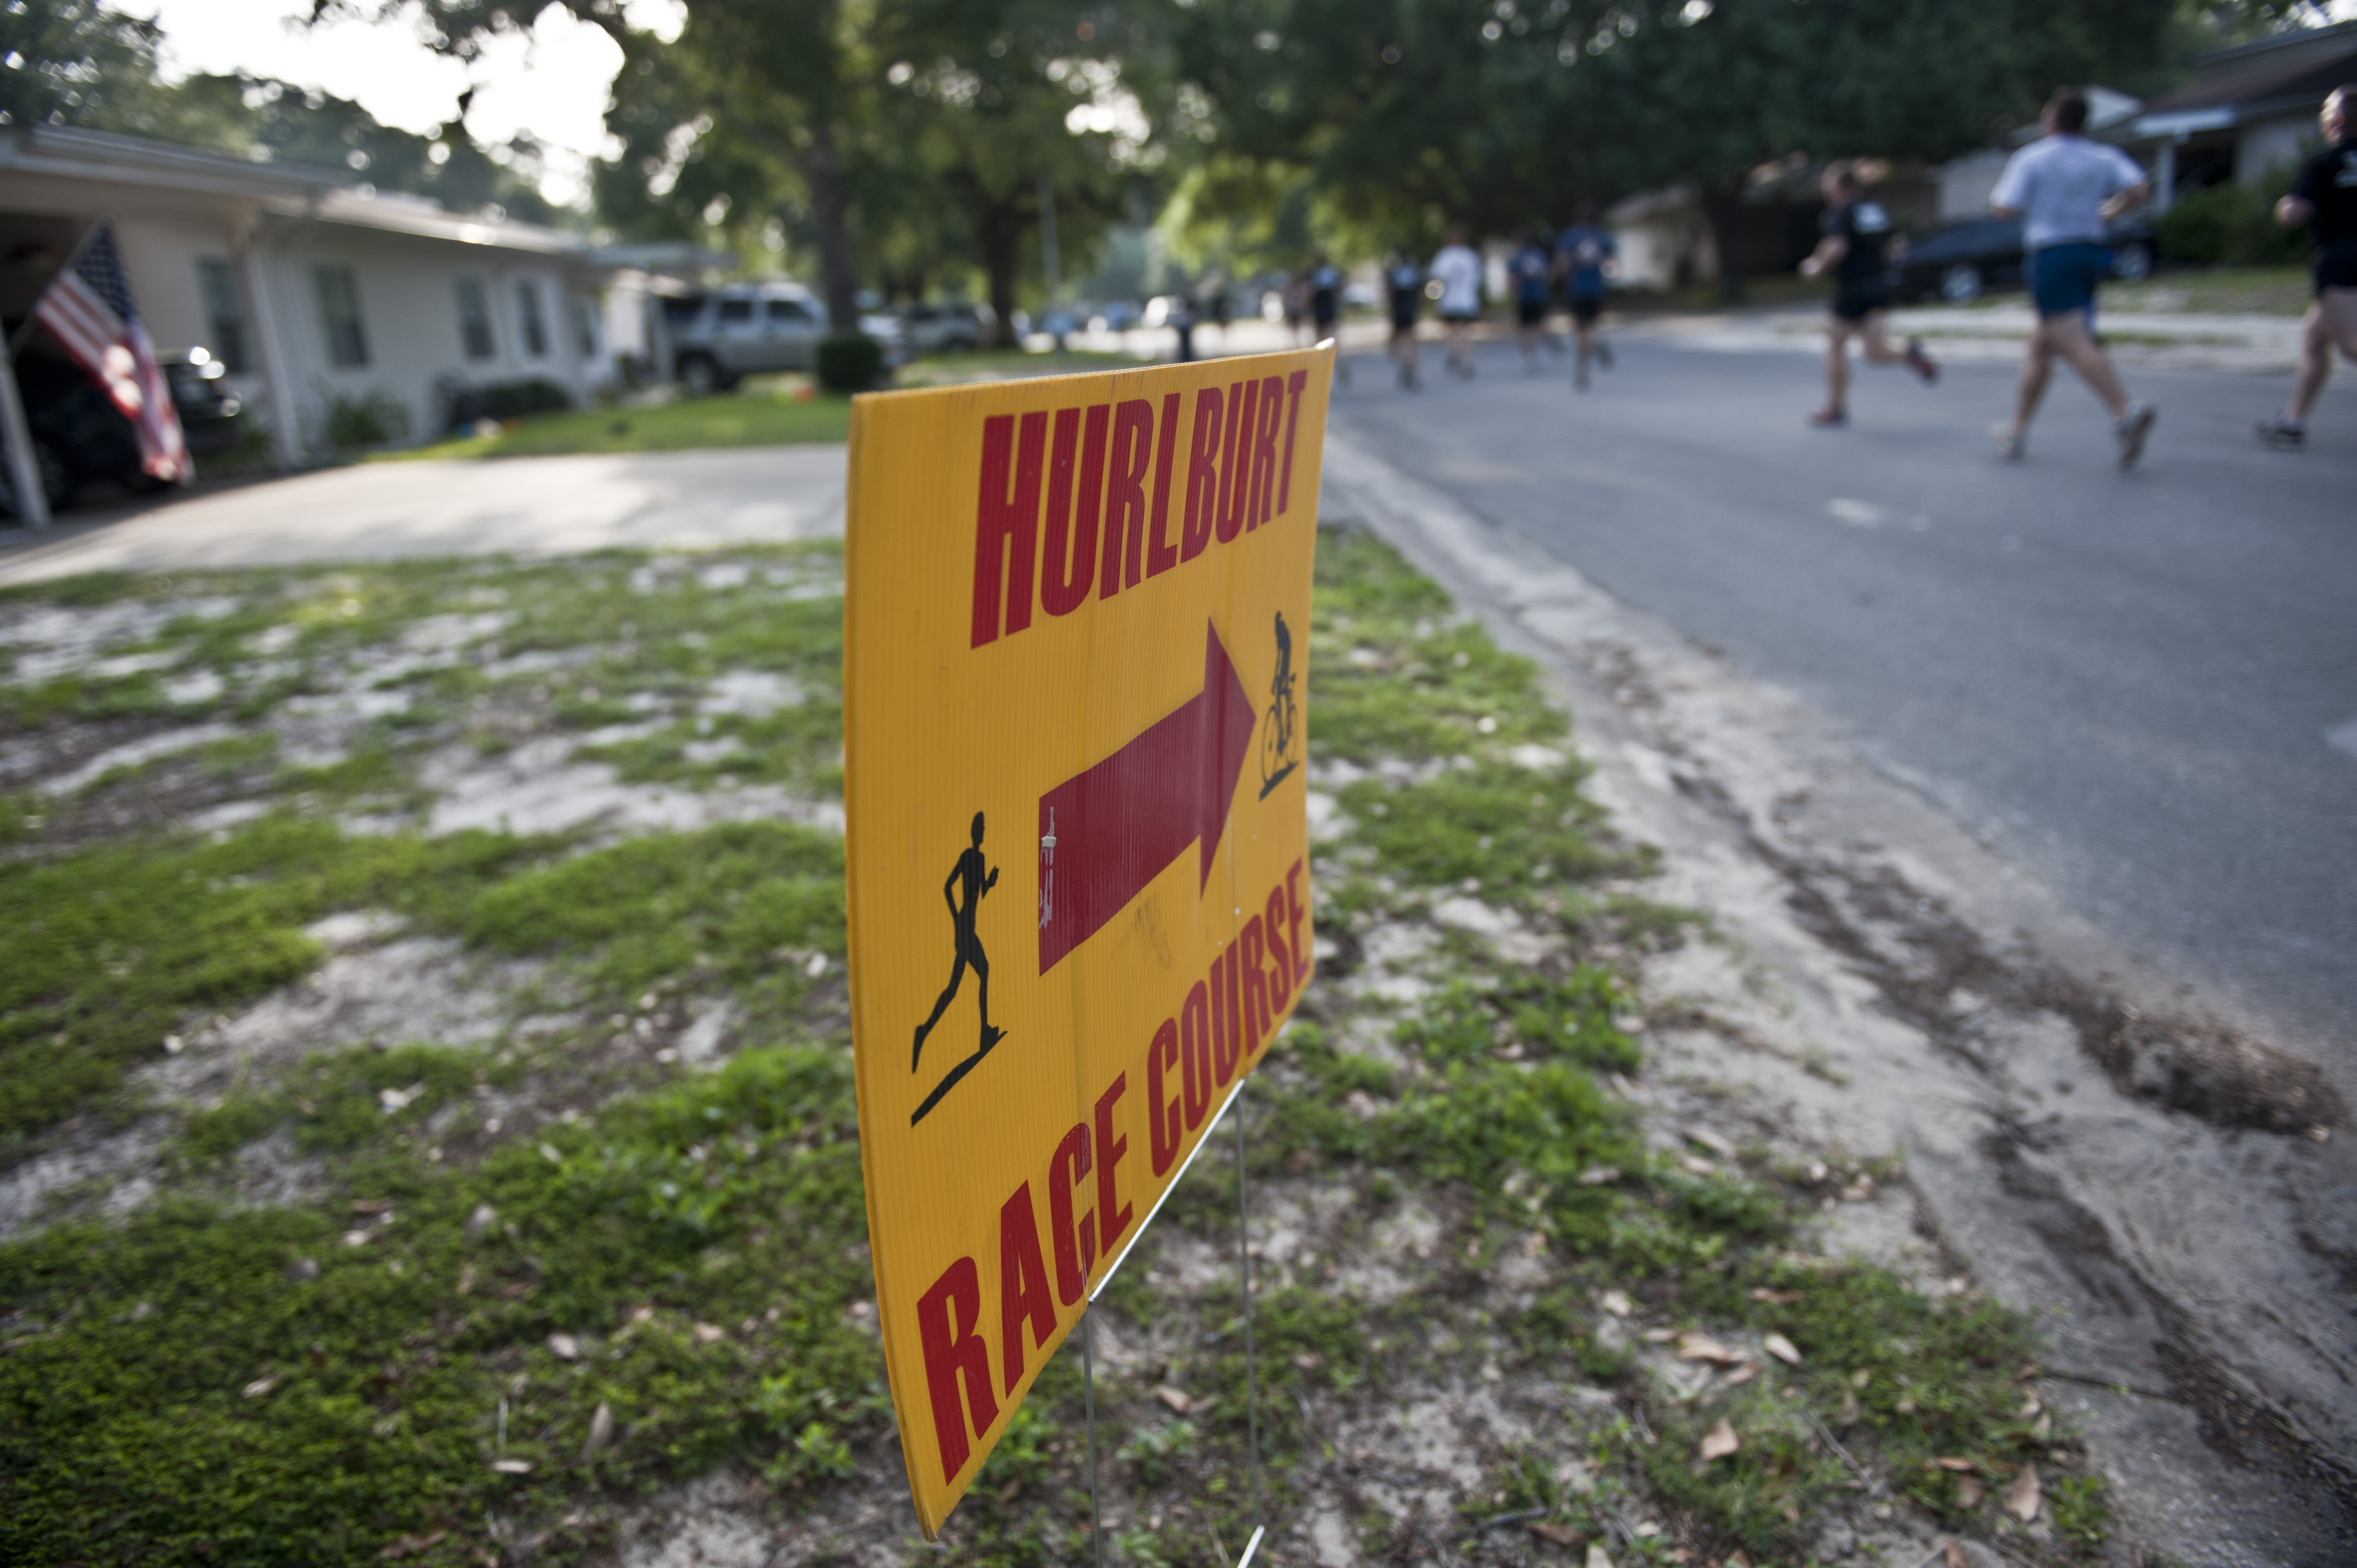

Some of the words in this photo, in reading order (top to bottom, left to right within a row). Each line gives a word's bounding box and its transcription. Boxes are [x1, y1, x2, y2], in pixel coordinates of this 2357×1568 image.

[971, 369, 1308, 649] HURLBURT
[917, 1071, 1133, 1486] RACE
[1147, 857, 1309, 1177] COURSE
